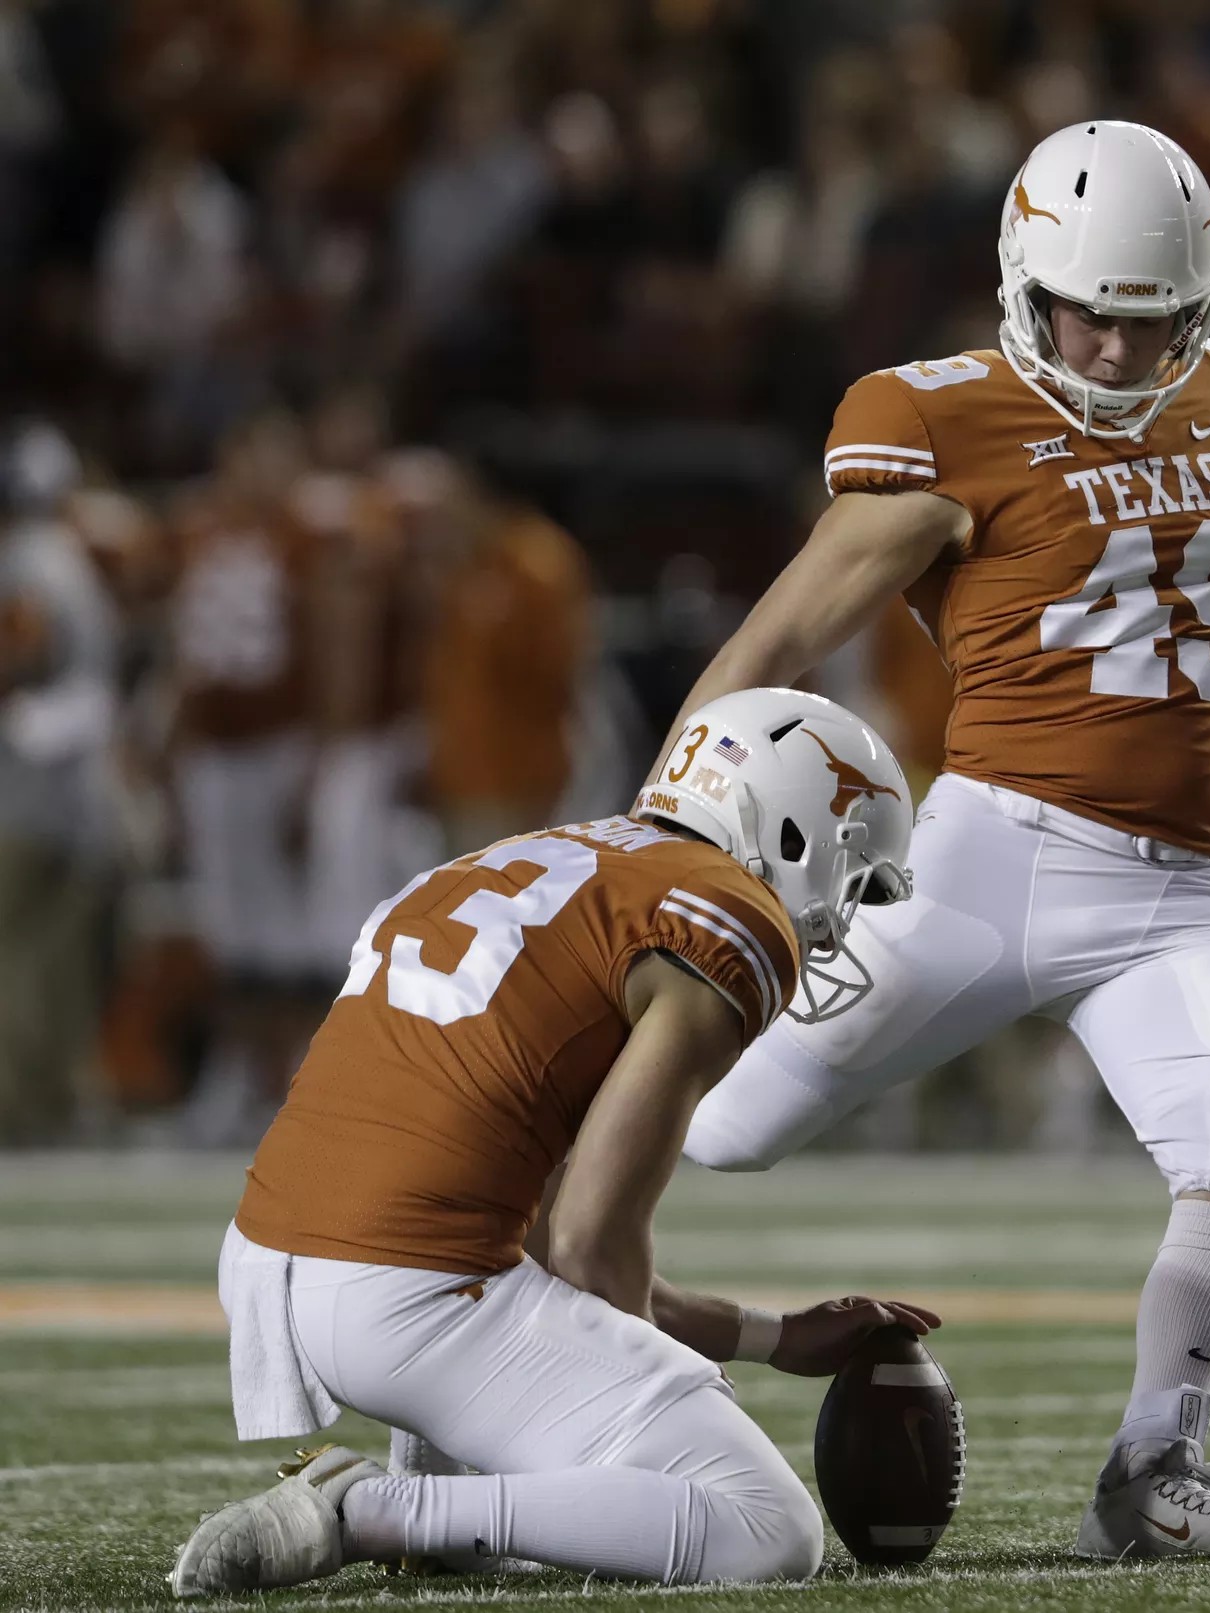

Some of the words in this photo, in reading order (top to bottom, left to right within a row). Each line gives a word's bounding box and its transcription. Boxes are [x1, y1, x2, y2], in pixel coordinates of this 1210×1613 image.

[1116, 283, 1158, 296] HORNS
[1169, 312, 1203, 353] Riddell
[1094, 403, 1123, 411] Riddell
